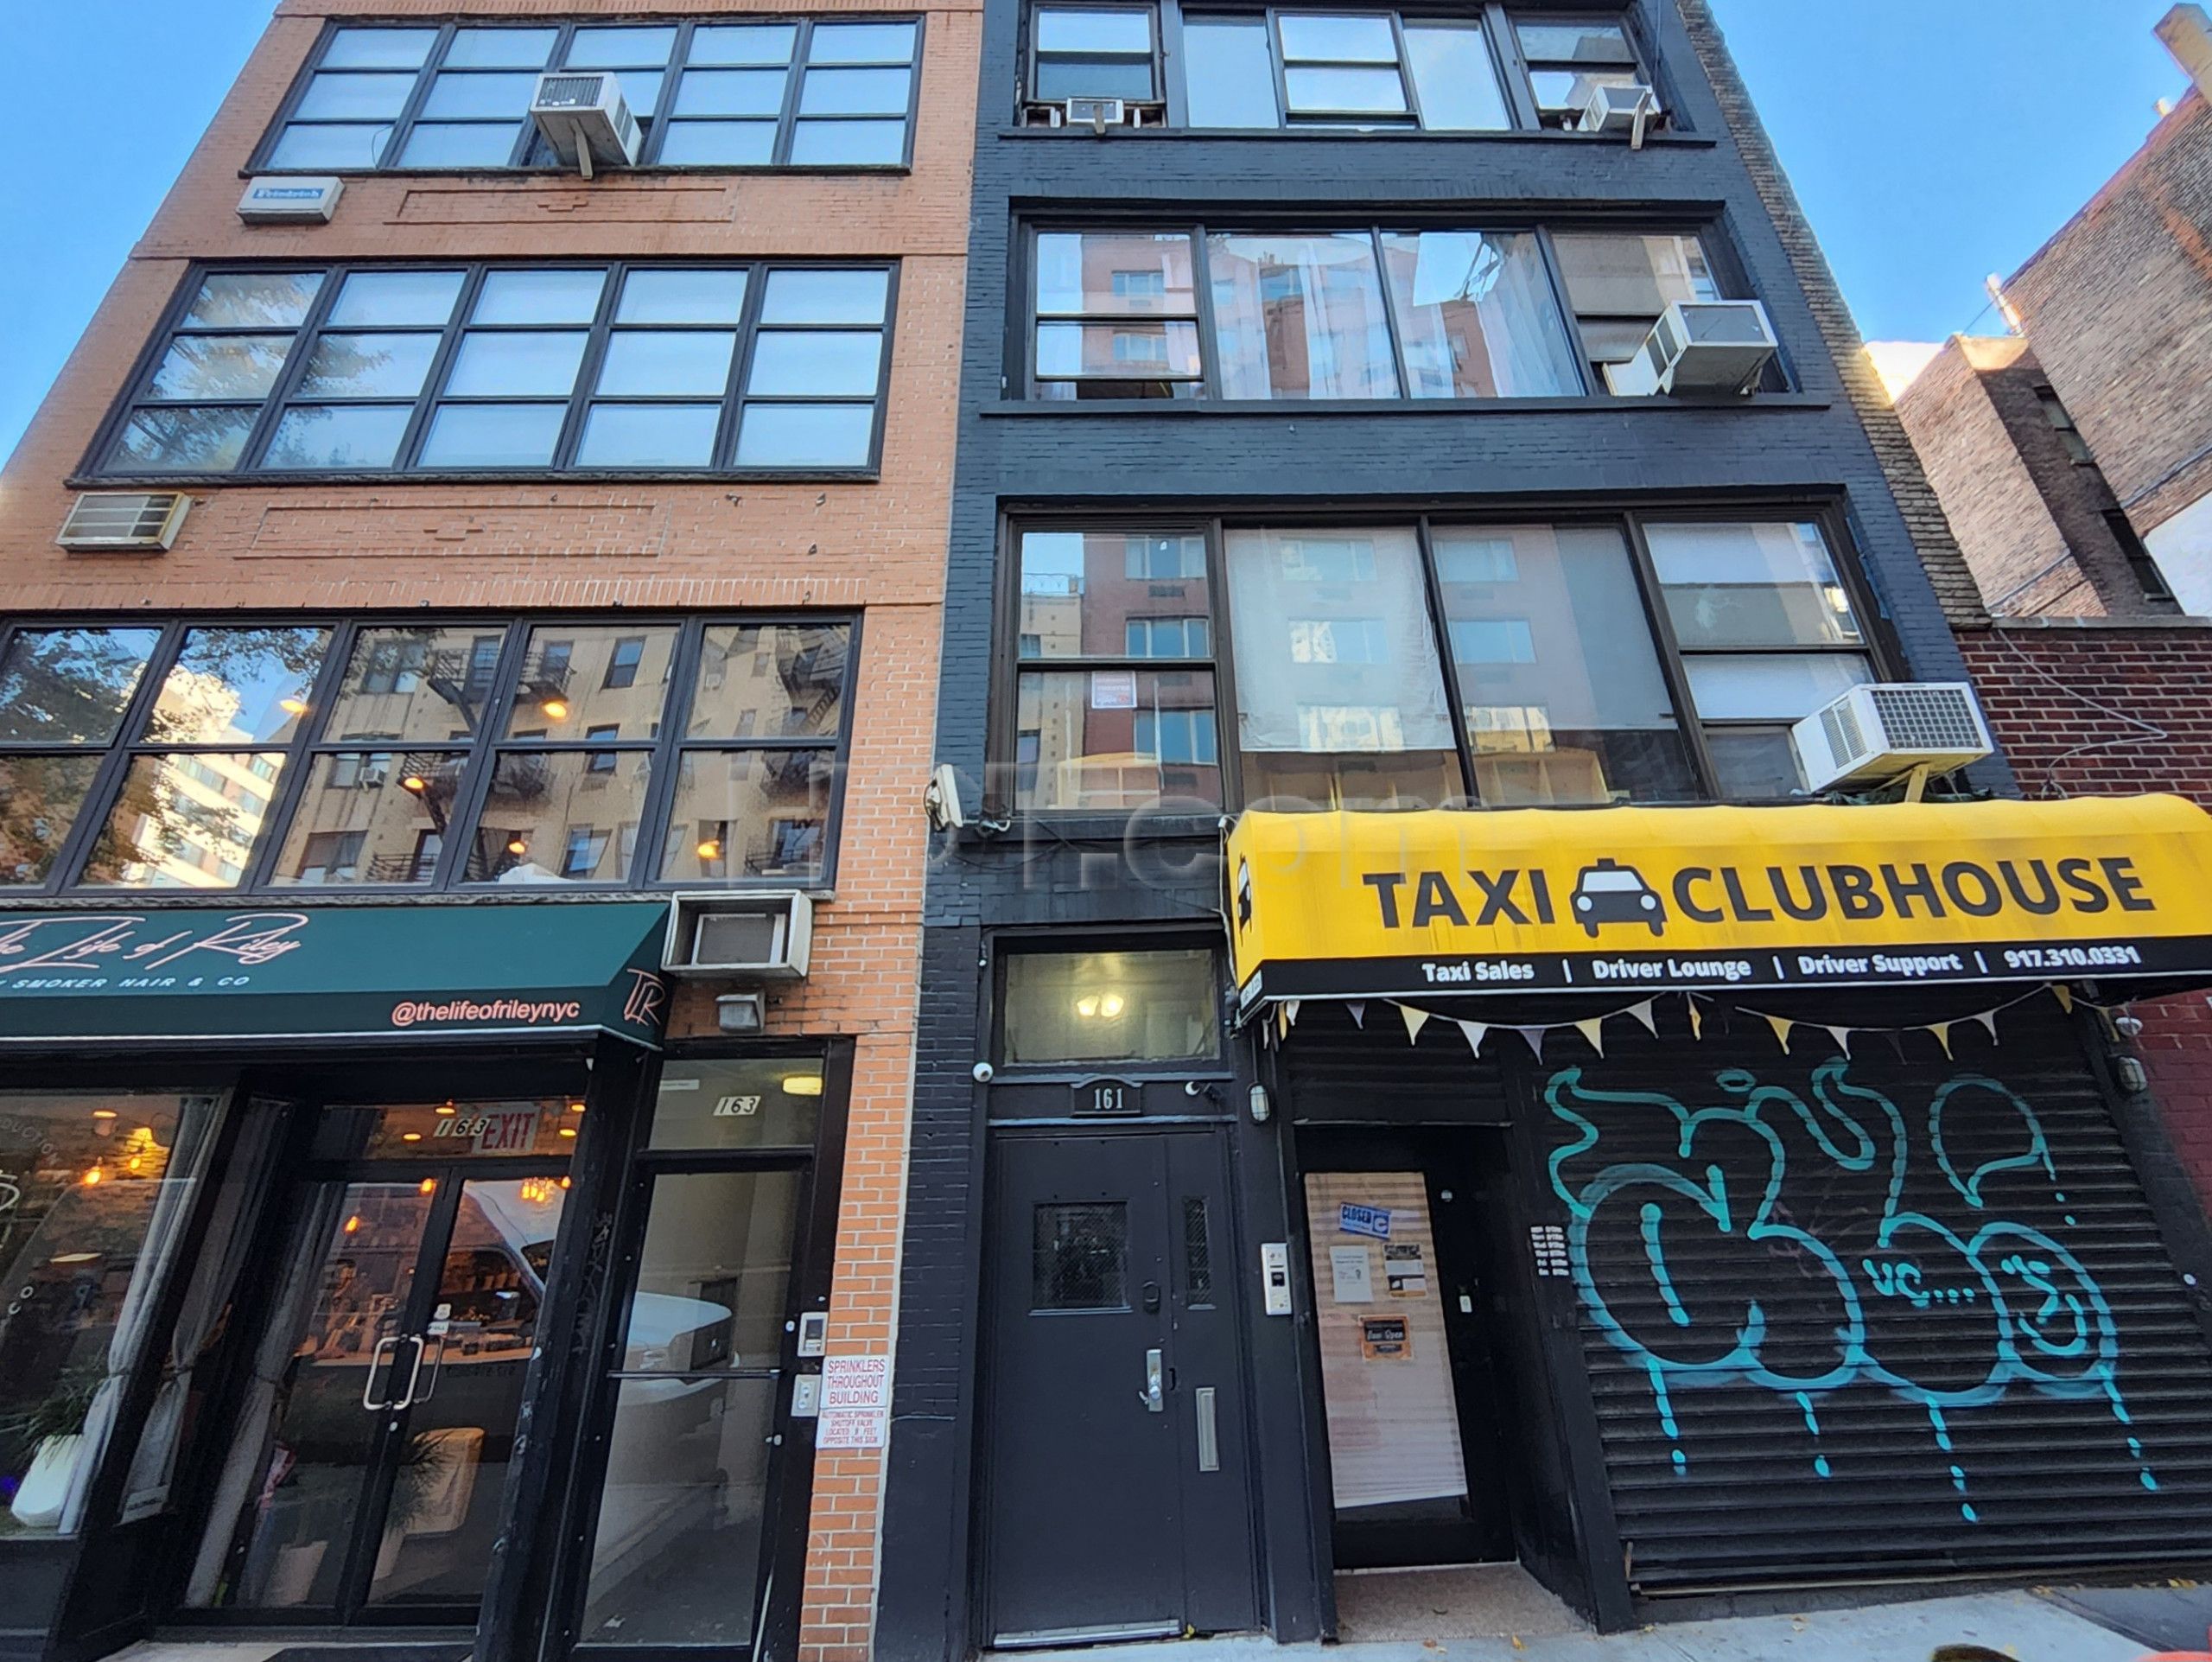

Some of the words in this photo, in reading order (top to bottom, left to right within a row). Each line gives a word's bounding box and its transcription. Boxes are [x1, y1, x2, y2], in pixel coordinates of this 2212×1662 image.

[1363, 868, 1555, 927] TAXI
[1673, 856, 2157, 923] CLUBHOUSE
[123, 930, 193, 959] of
[145, 913, 308, 970] Riley
[1421, 962, 1470, 983] Taxi
[1475, 960, 1535, 981] Sales
[1592, 958, 1663, 979] Driver
[1667, 958, 1752, 981] Lounge
[1798, 954, 1868, 975] Driver
[1872, 952, 1963, 977] Support
[2004, 945, 2142, 969] 917.310.0331
[12, 977, 108, 990] SMOKER
[118, 977, 176, 989] HAIR
[187, 976, 204, 987] &
[217, 975, 251, 987] CO
[391, 999, 582, 1027] @thelifeofrileynyc
[719, 1098, 757, 1114] 163
[1094, 1088, 1122, 1109] 161
[438, 1119, 487, 1136] 163
[481, 1112, 536, 1149] EXIT
[828, 1359, 886, 1374] SPRINKLERS
[827, 1374, 885, 1389] THROUGHOUT
[829, 1390, 879, 1404] BUILDING
